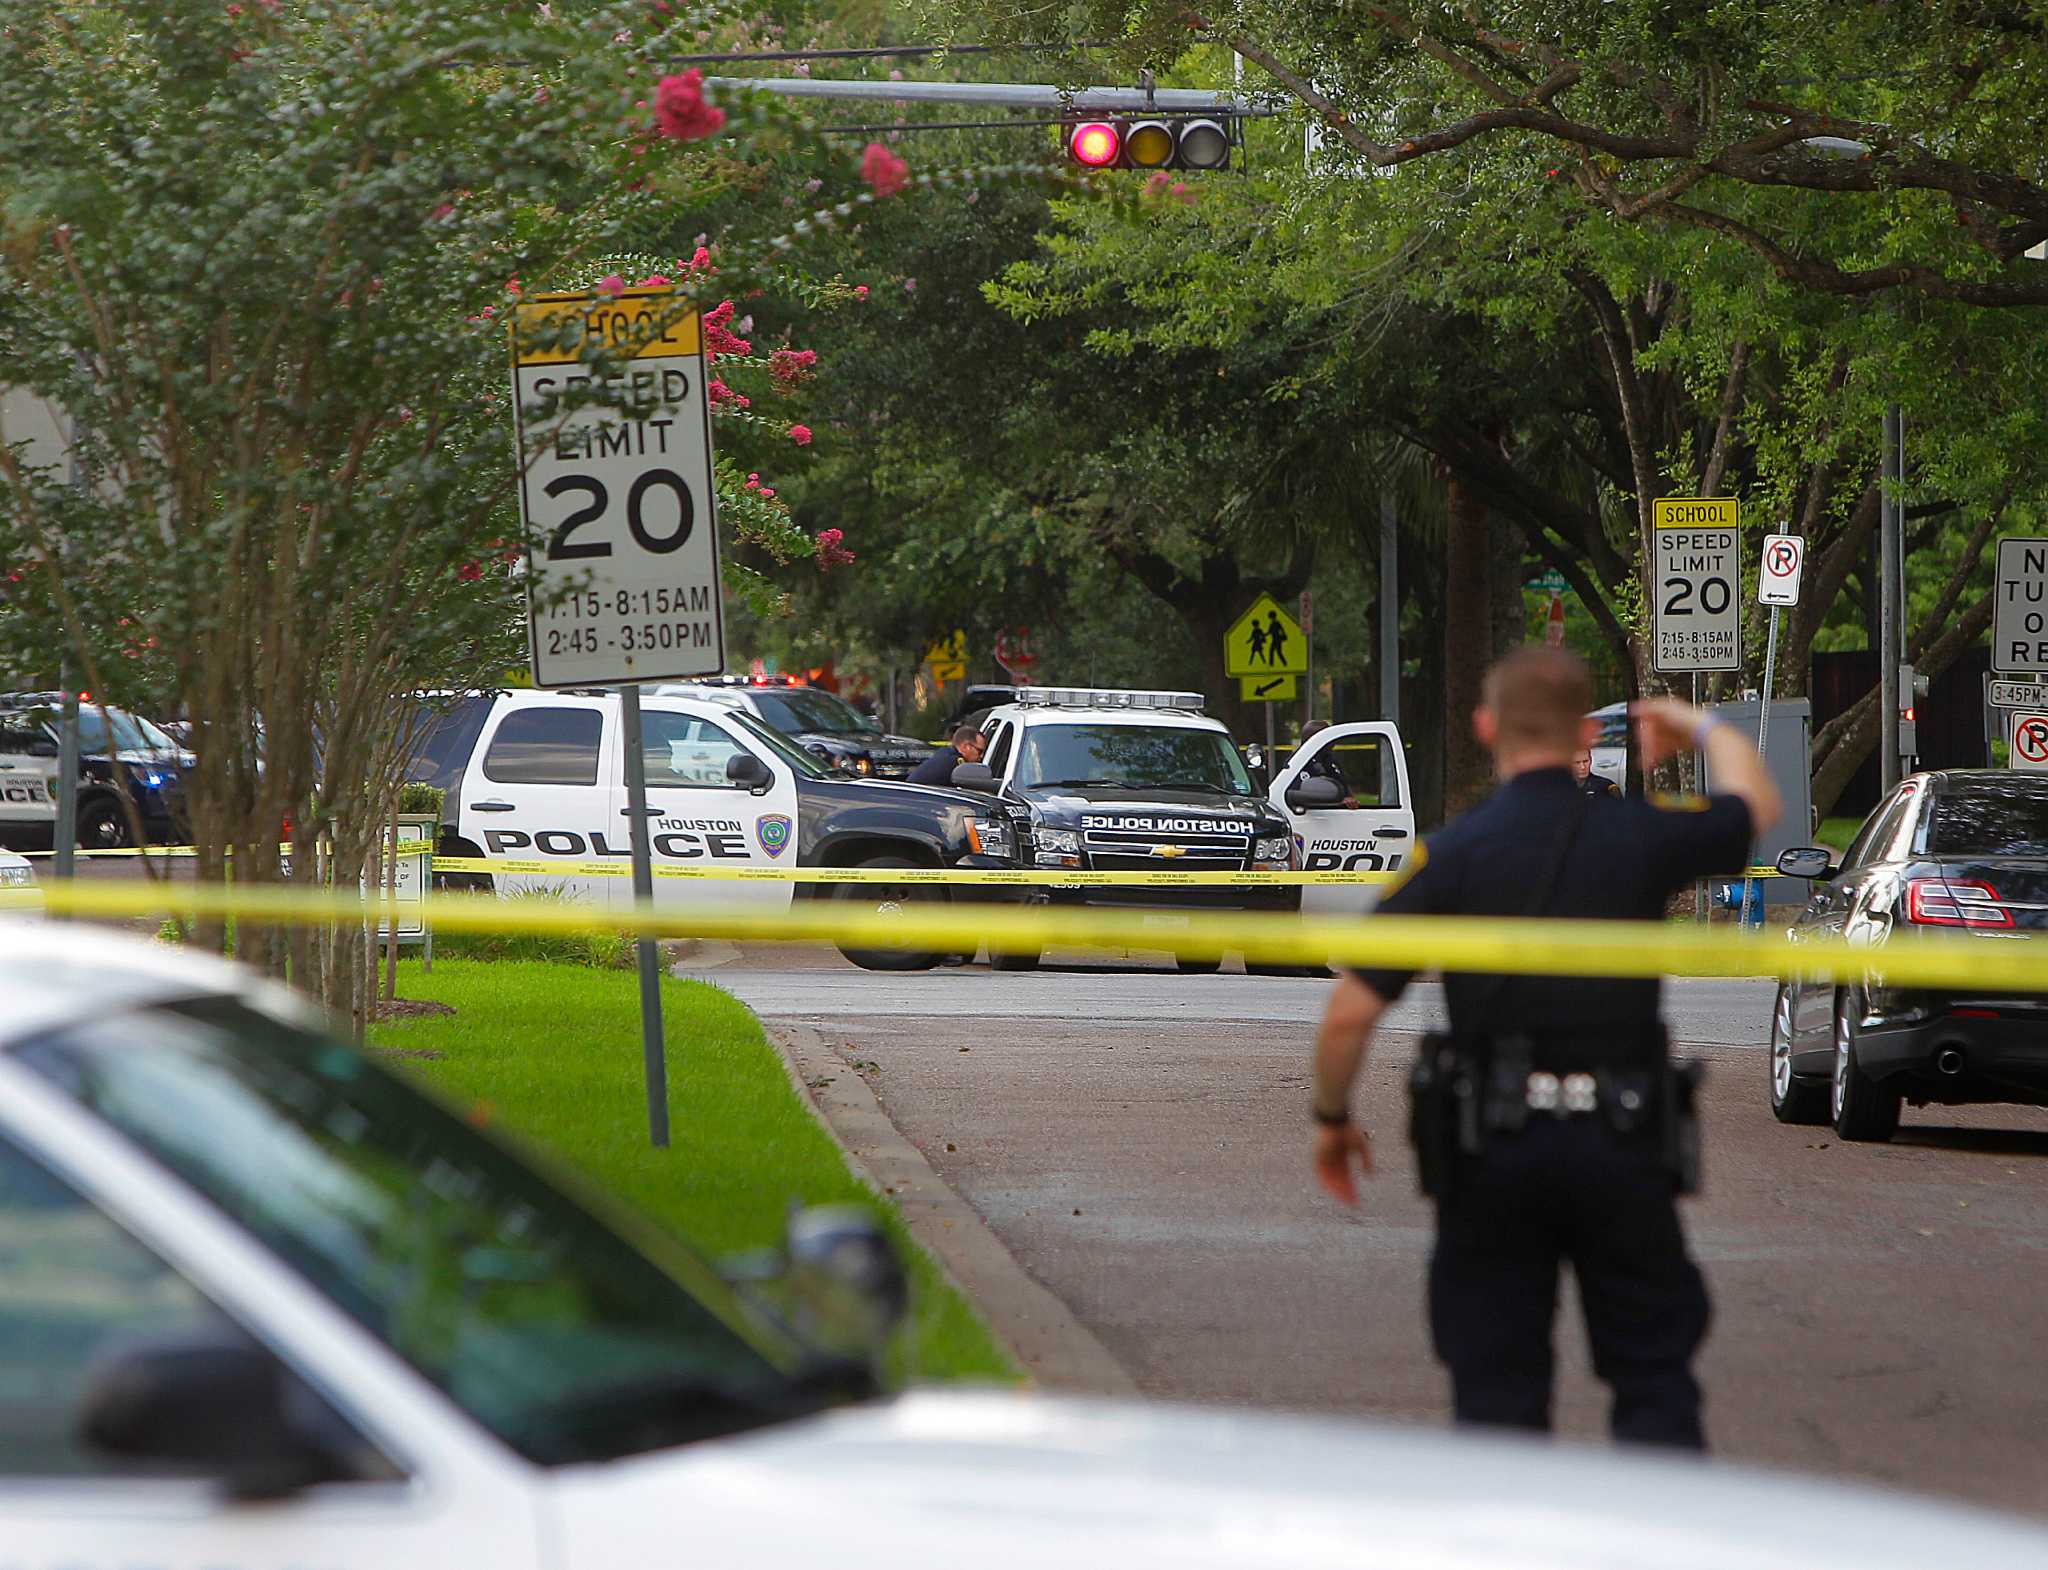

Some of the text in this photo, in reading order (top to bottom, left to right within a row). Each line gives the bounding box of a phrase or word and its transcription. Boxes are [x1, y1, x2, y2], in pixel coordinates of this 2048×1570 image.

[540, 309, 678, 350] HOOL
[543, 468, 694, 561] 20
[1665, 506, 1728, 522] SCHOOL
[1662, 534, 1732, 550] SPEED
[1669, 556, 1724, 572] LIMIT
[1664, 577, 1731, 616] 20
[657, 818, 742, 832] HOUSTON
[483, 829, 752, 859] POLCE
[1310, 839, 1378, 851] HOUSTON
